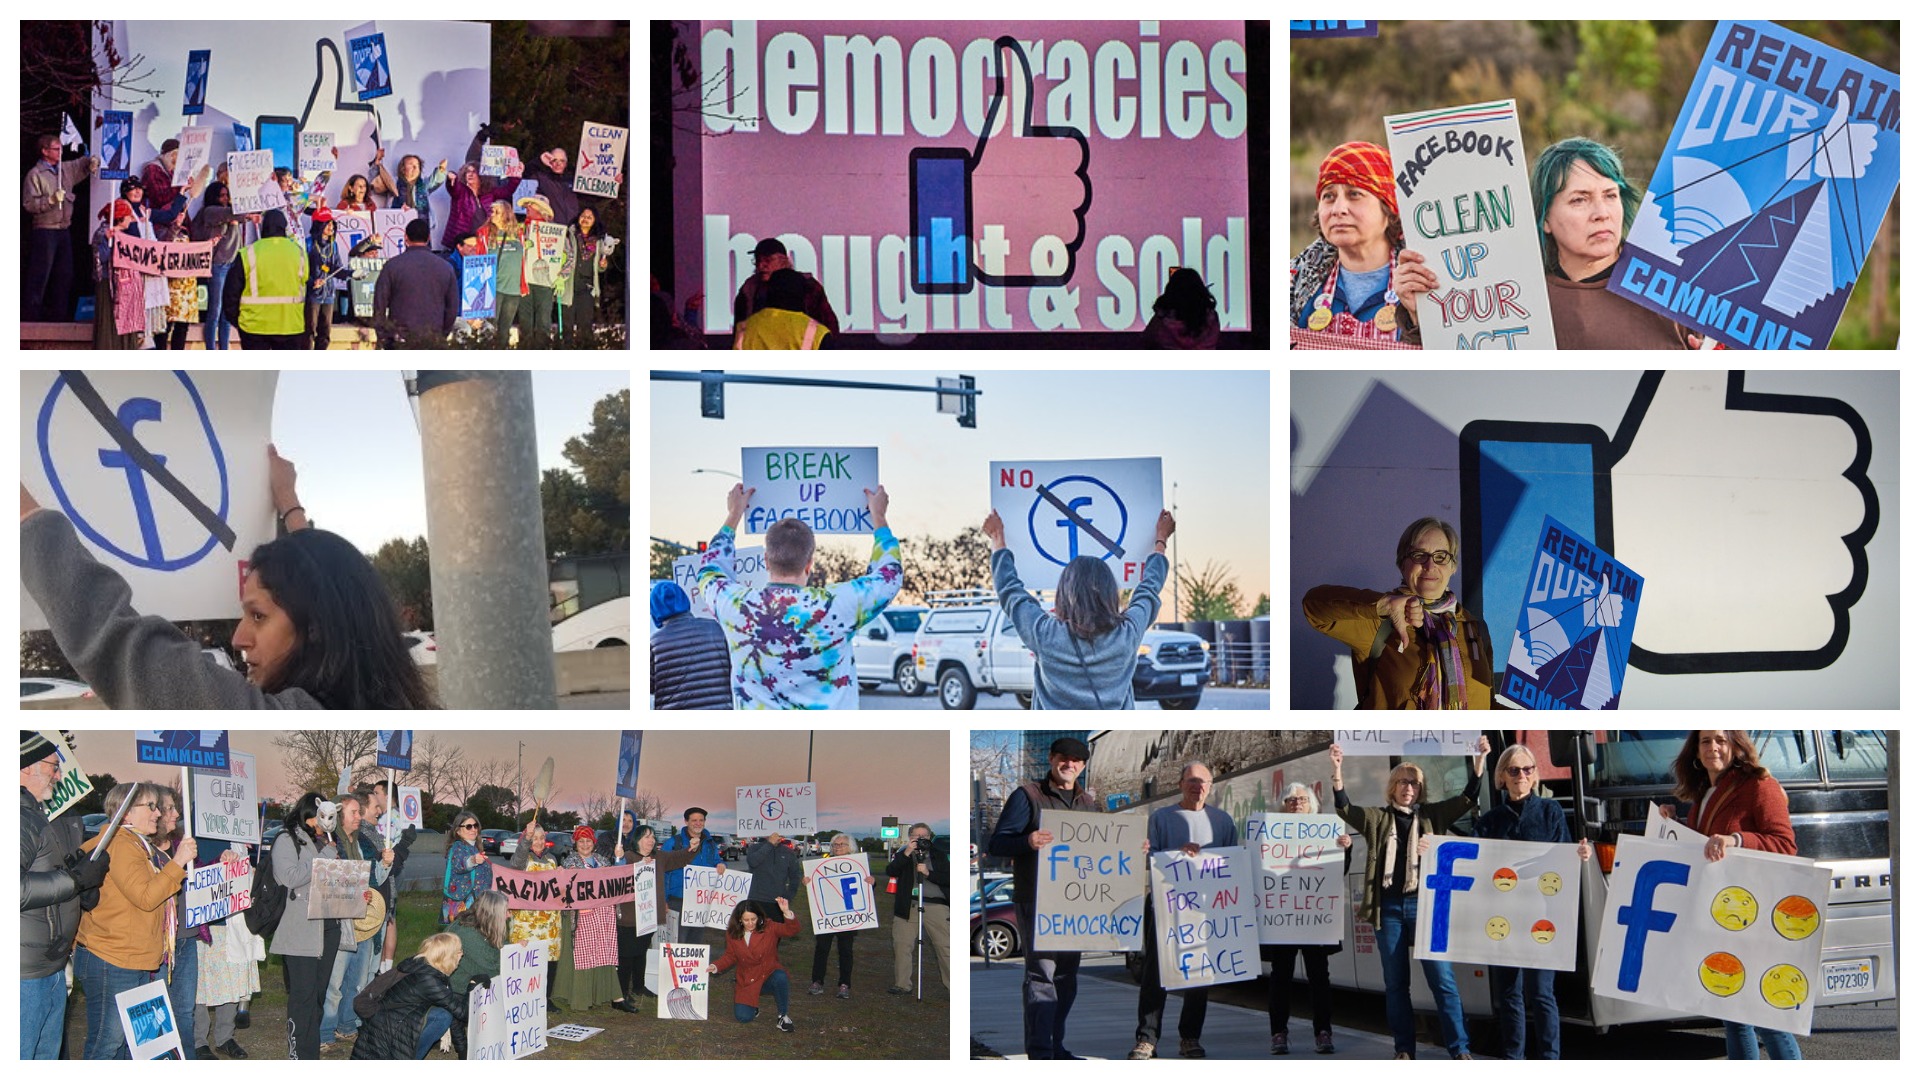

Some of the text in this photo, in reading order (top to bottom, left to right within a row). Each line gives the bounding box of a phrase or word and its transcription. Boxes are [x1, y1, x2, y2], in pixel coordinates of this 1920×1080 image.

[701, 20, 1247, 139] democracies
[1677, 65, 1819, 150] OUR
[588, 126, 623, 139] CLEAN
[600, 143, 612, 152] UP
[595, 154, 615, 165] YOUR
[1396, 130, 1515, 198] FACEBOOK
[600, 166, 618, 177] ACT
[576, 176, 617, 197] FACEBOOK
[386, 214, 405, 225] NO
[1413, 184, 1515, 239] CLEAN
[339, 218, 359, 230] NO
[168, 252, 210, 271] GRANNIES
[1441, 242, 1489, 281] UP
[1028, 234, 1081, 330] &
[1427, 279, 1531, 328] YOUR
[1455, 325, 1529, 350] ACT
[766, 452, 852, 481] BREAK
[1001, 469, 1033, 488] NO
[800, 483, 826, 502] UP
[1124, 562, 1145, 582] F
[1543, 526, 1638, 603] RECLAIM
[1529, 551, 1596, 604] OUR
[1412, 730, 1463, 744] HATE
[142, 745, 225, 767] COMMONS
[211, 778, 245, 800] CLEAN
[737, 786, 812, 799] FAKE NEWS
[222, 800, 240, 816] UP
[203, 812, 254, 836] YOUR ACT
[738, 818, 807, 831] REAL HATE
[1060, 821, 1129, 844] DON'T
[1247, 820, 1342, 841] FACEBOOK
[1261, 844, 1325, 860] POLICY
[824, 861, 853, 875] NO
[1165, 856, 1231, 882] TIME
[211, 880, 234, 902] WHILE
[496, 876, 561, 901] RAGING
[1064, 881, 1115, 902] OUR
[1264, 876, 1325, 892] DENY
[230, 889, 251, 914] DIES
[1166, 886, 1239, 913] FOR AN
[1254, 894, 1339, 910] DEFLECT
[683, 909, 730, 926] DEMOCRAC
[817, 912, 876, 930] FACEBOOK
[1037, 913, 1142, 936] DEMOCRACY
[1264, 913, 1333, 926] NOTHING
[1166, 915, 1254, 945] ABOUT-
[508, 948, 540, 970] TIME
[663, 947, 705, 958] FACEBOOK
[675, 960, 699, 968] CLEAN
[506, 974, 541, 998] FOR AN
[679, 975, 699, 983] YOUR
[691, 983, 706, 991] ACT
[1827, 972, 1869, 992] CP92309
[129, 996, 165, 1020] RECLAIM
[505, 998, 545, 1025] ABOUT-
